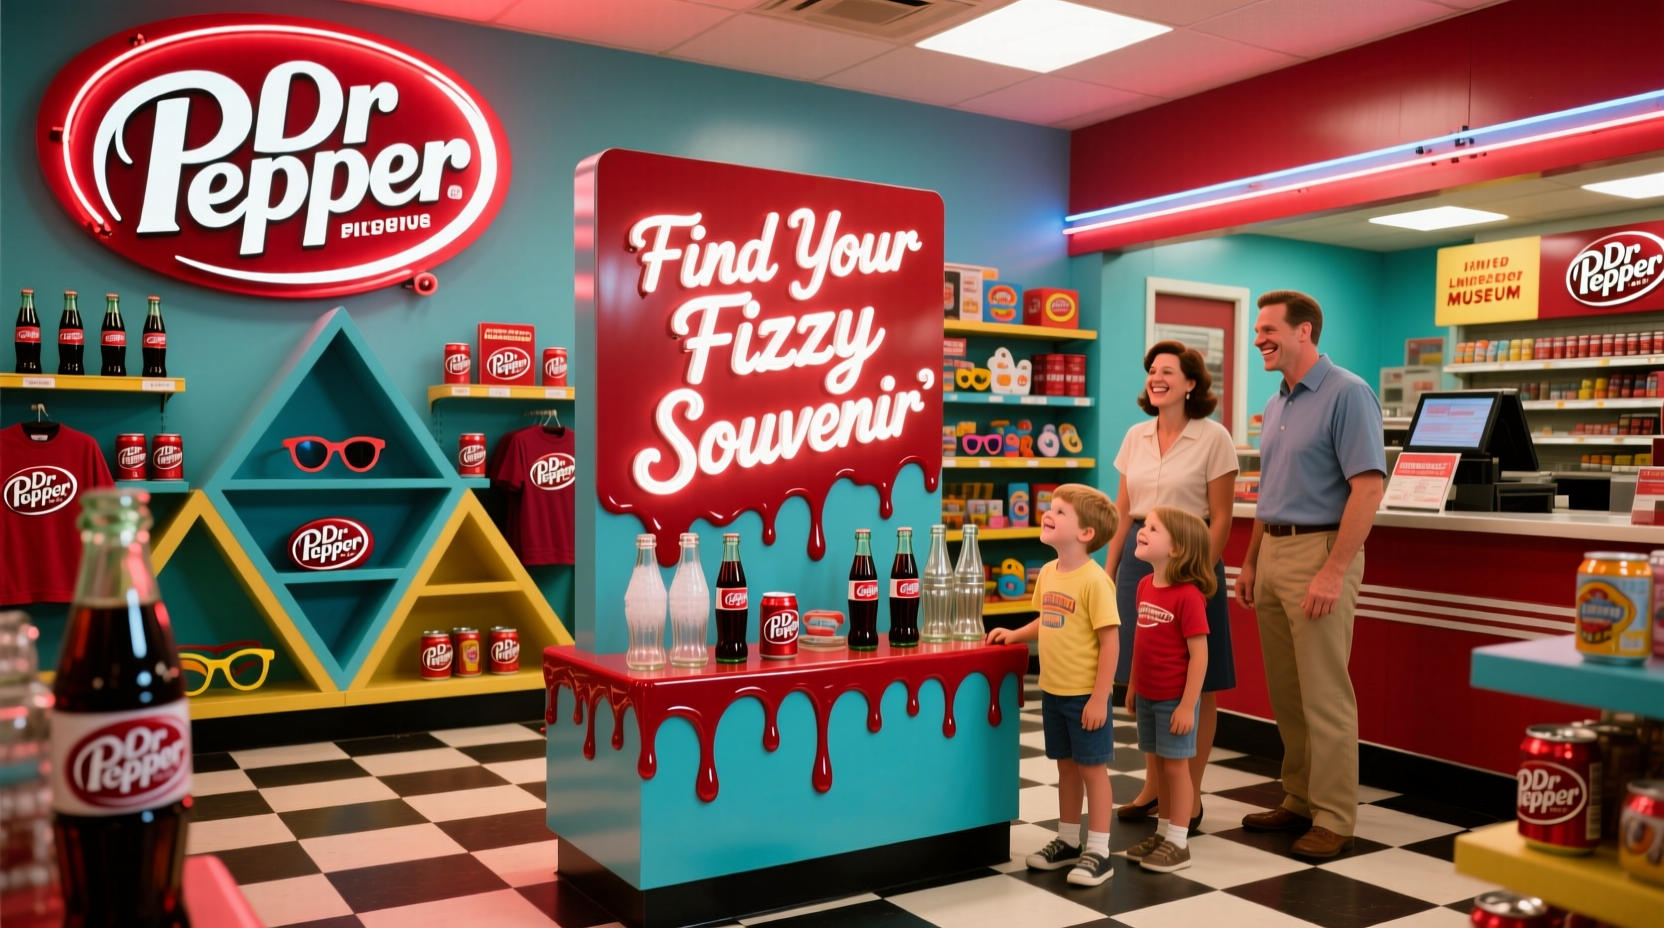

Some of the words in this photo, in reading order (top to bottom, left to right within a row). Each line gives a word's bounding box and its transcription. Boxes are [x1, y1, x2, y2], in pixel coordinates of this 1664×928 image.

[254, 60, 399, 153] Dr
[93, 70, 471, 256] Pepper
[629, 211, 779, 293] Find
[787, 207, 922, 300] Your
[1573, 249, 1663, 297] Pepper
[1603, 241, 1641, 271] Dr
[1447, 284, 1521, 307] MUSEUM
[671, 291, 886, 395] Fizzy
[31, 471, 57, 490] Dr
[322, 525, 348, 544] Dr
[124, 726, 168, 760] Dr
[74, 734, 184, 794] Pepper
[1531, 768, 1562, 791] Dr
